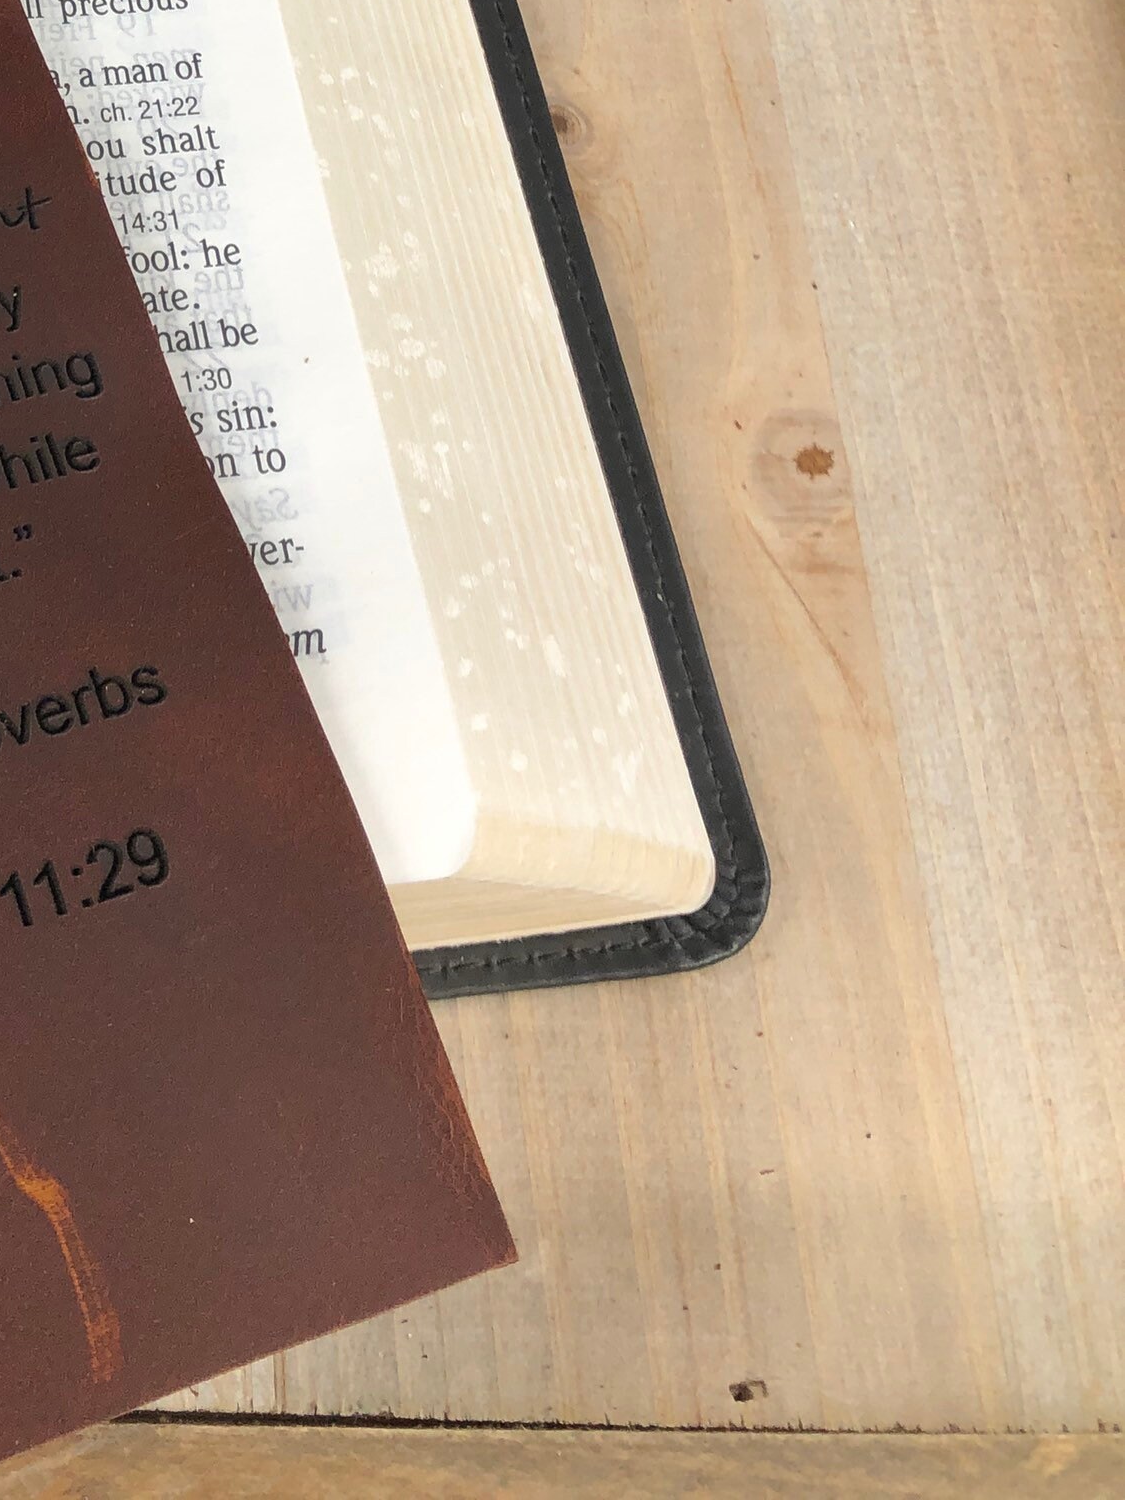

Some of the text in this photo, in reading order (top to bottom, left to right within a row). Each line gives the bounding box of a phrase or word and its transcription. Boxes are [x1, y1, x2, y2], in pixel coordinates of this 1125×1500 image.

[100, 95, 201, 124] ch. 21:22
[116, 208, 179, 236] 14:31
[216, 399, 278, 433] sin:
[251, 444, 287, 475] to
